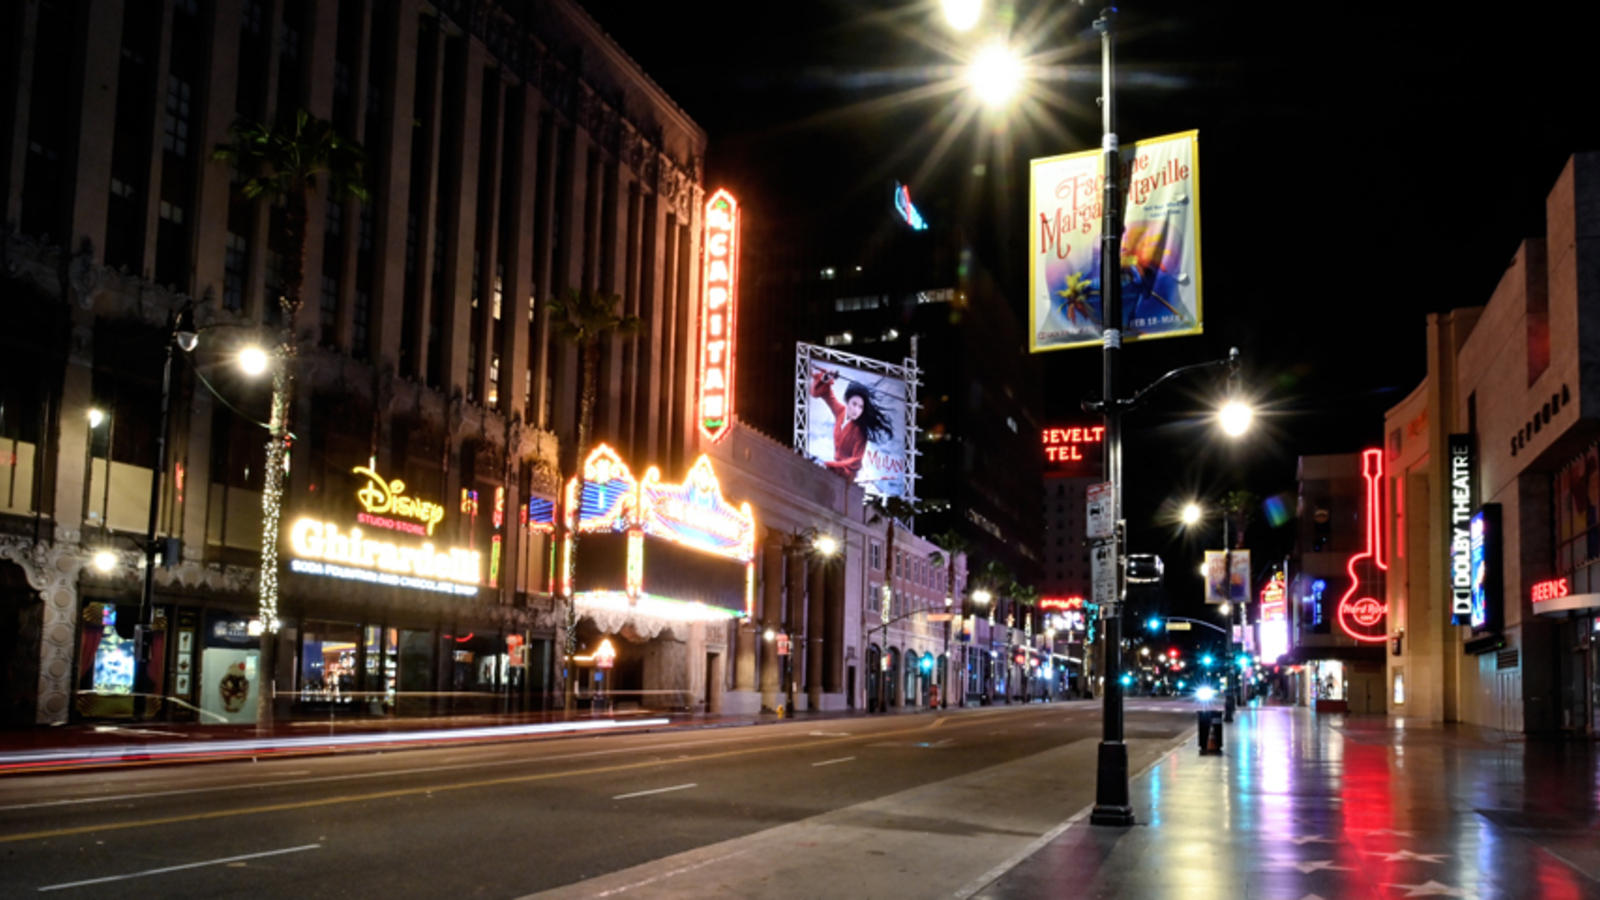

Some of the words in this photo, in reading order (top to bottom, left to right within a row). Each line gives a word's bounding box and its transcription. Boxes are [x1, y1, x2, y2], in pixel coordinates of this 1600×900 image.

[1510, 382, 1571, 457] SEPHORA
[1452, 445, 1470, 525] THEATRE
[290, 518, 481, 584] Ghirardelli
[357, 513, 394, 530] STUDIO
[395, 520, 426, 536] STORE
[1453, 527, 1471, 586] DOLBY
